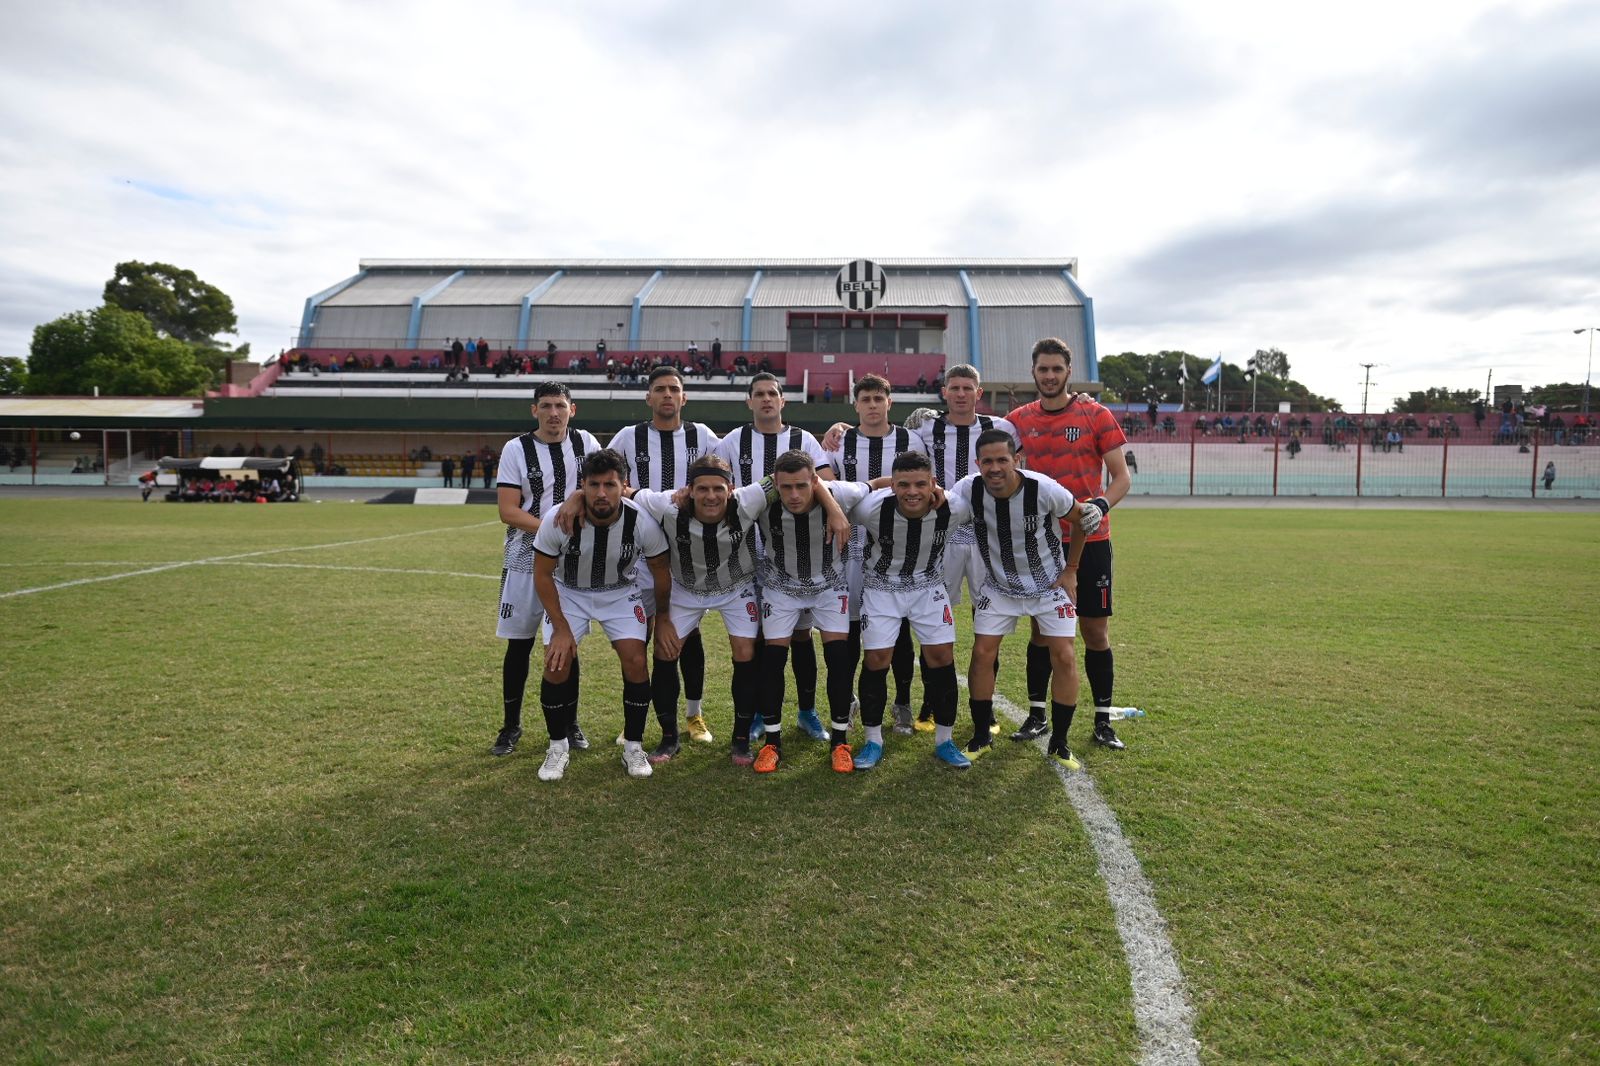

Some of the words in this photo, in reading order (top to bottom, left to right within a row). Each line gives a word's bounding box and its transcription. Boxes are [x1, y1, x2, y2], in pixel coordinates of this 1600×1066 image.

[843, 282, 879, 291] BELL
[837, 595, 848, 615] 7
[1101, 588, 1107, 609] 1
[746, 602, 758, 622] 9
[943, 604, 953, 626] 4
